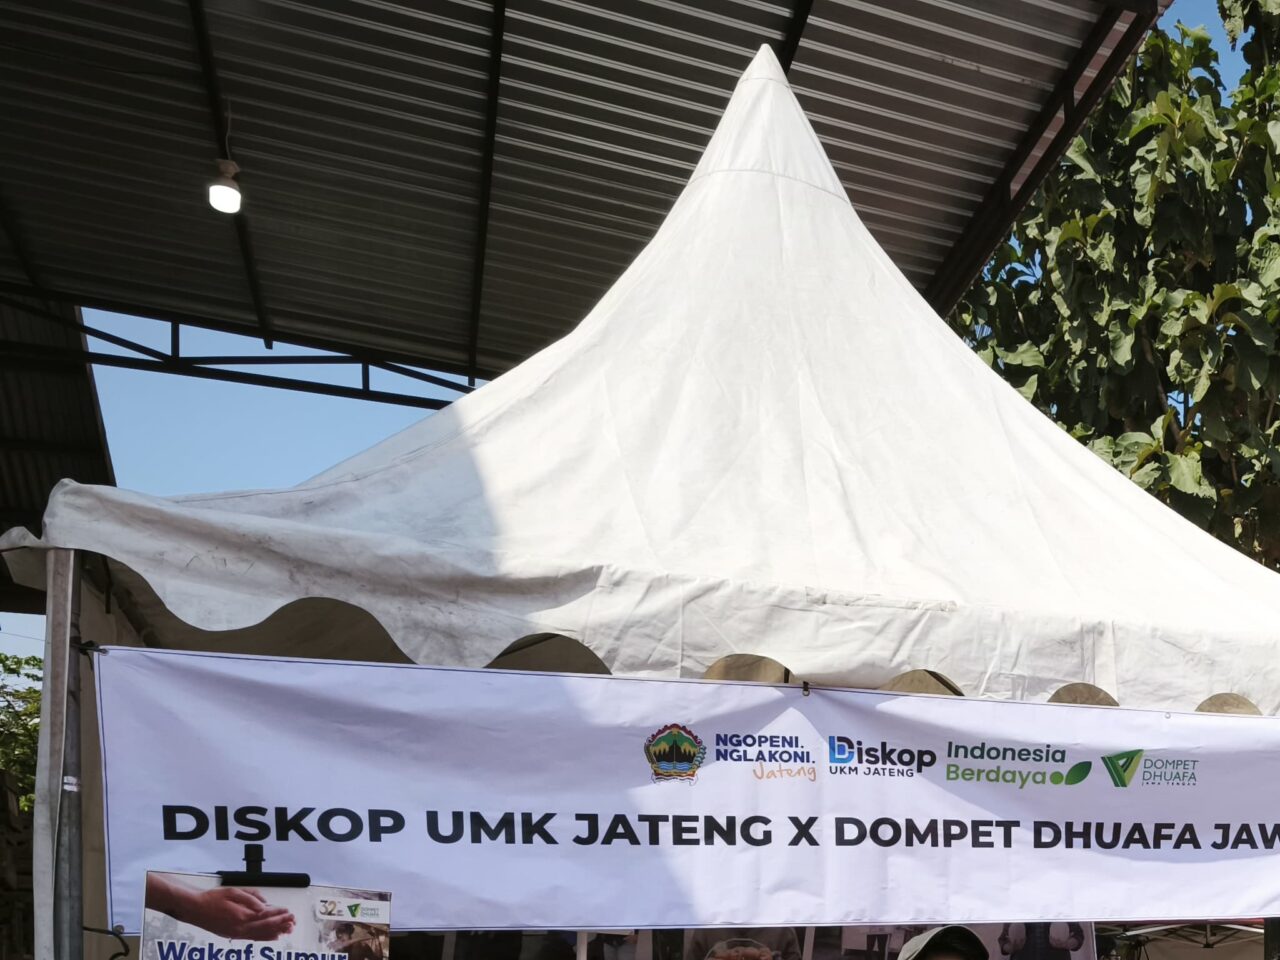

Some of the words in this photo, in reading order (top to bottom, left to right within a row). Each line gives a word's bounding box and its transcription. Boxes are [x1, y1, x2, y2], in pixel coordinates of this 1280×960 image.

[715, 733, 804, 749] NGOPENI.
[715, 749, 816, 764] NGLAKONI.
[828, 735, 937, 772] Diskop
[947, 741, 1067, 764] Indonesia
[752, 761, 817, 782] Jateng
[829, 766, 859, 776] UKM
[863, 766, 914, 777] JATENG
[1143, 758, 1200, 770] DOMPET
[946, 763, 1047, 789] Berdaya
[1142, 770, 1197, 782] DHUAFA
[161, 805, 406, 843] DISKOP
[426, 810, 562, 847] UMK
[572, 812, 773, 847] JATENG
[788, 815, 821, 848] X
[833, 816, 1021, 849] DOMPET
[1032, 820, 1202, 850] DHUAFA
